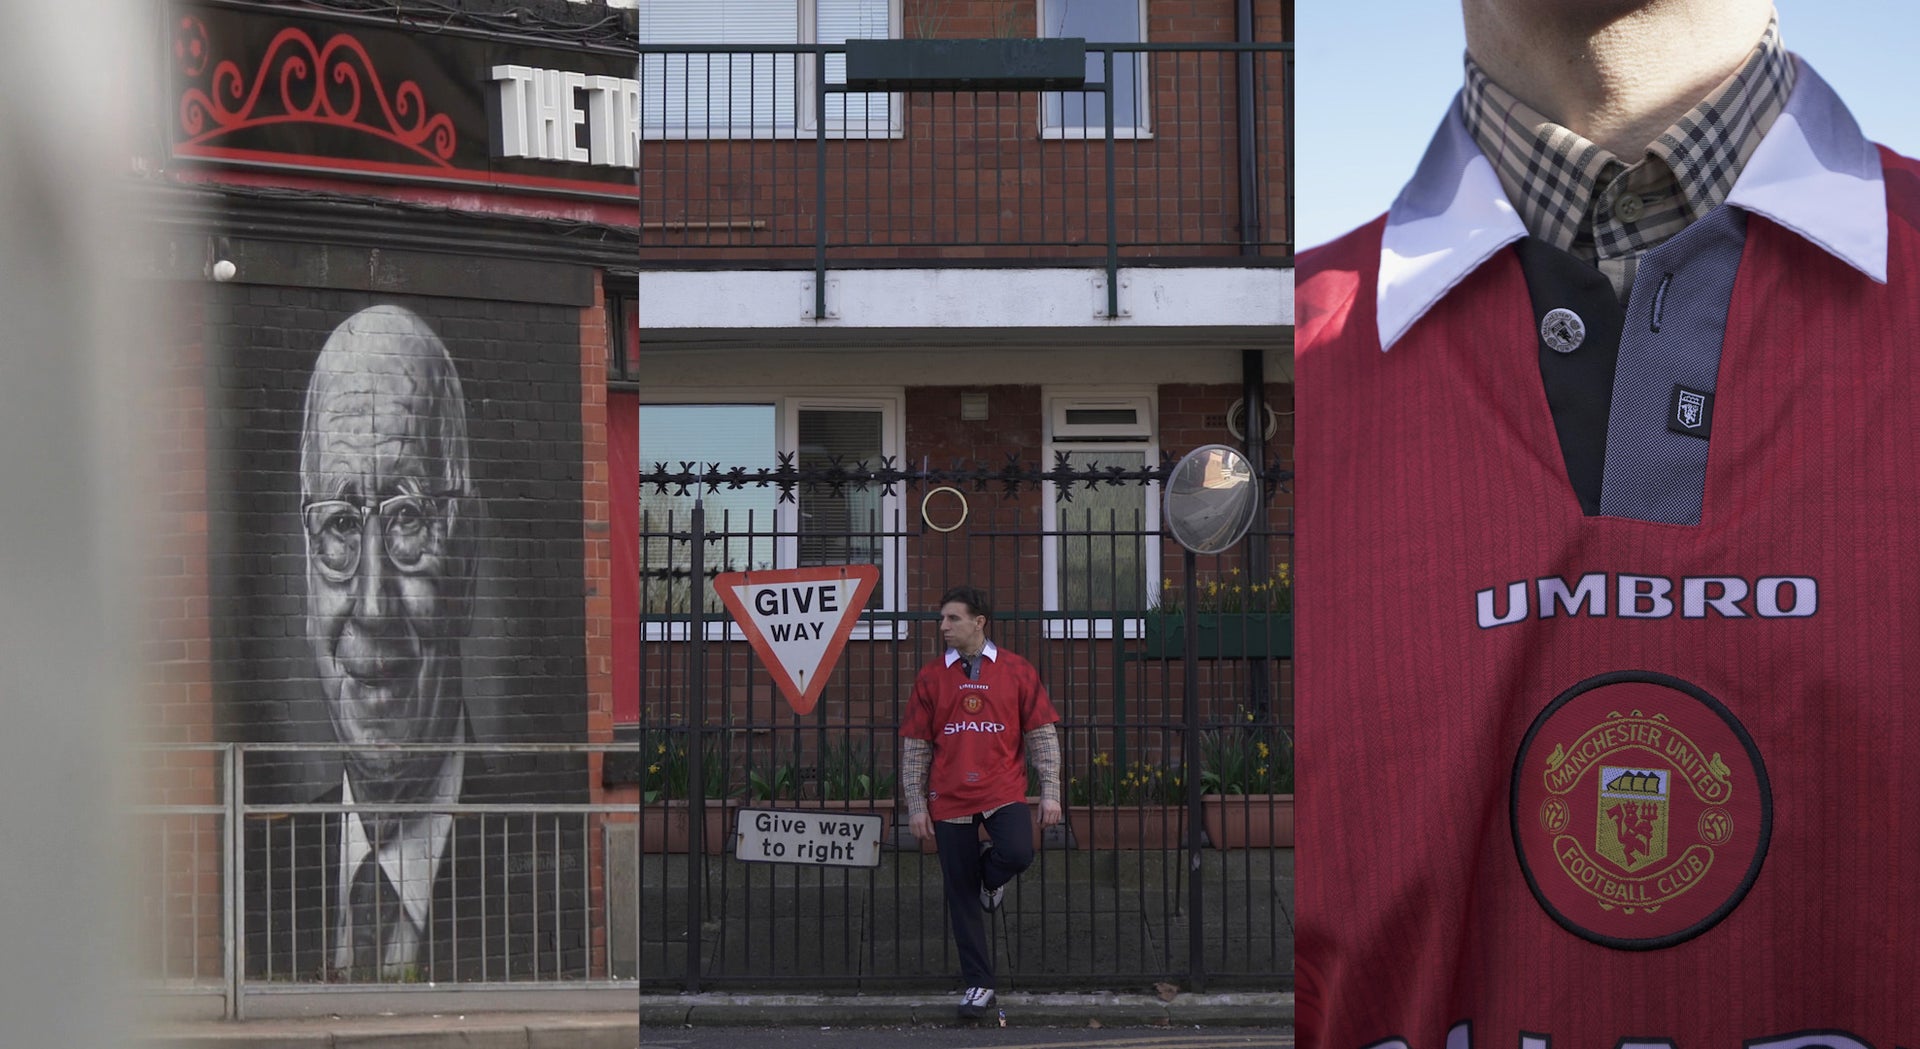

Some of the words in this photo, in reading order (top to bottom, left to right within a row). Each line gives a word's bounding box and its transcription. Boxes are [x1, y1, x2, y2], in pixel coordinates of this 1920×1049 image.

[492, 64, 589, 162] THE
[755, 585, 838, 616] GIVE
[1475, 572, 1819, 630] UMBRO
[770, 621, 824, 642] WAY
[943, 720, 1006, 735] SHARP
[1551, 723, 1662, 789] MANCHESTER
[1664, 736, 1722, 798] UNITED
[755, 813, 806, 834] Give
[819, 821, 864, 841] way
[762, 837, 786, 857] to
[797, 840, 855, 862] right
[1562, 846, 1651, 901] FOOTBALL
[1657, 854, 1704, 894] CLUB
